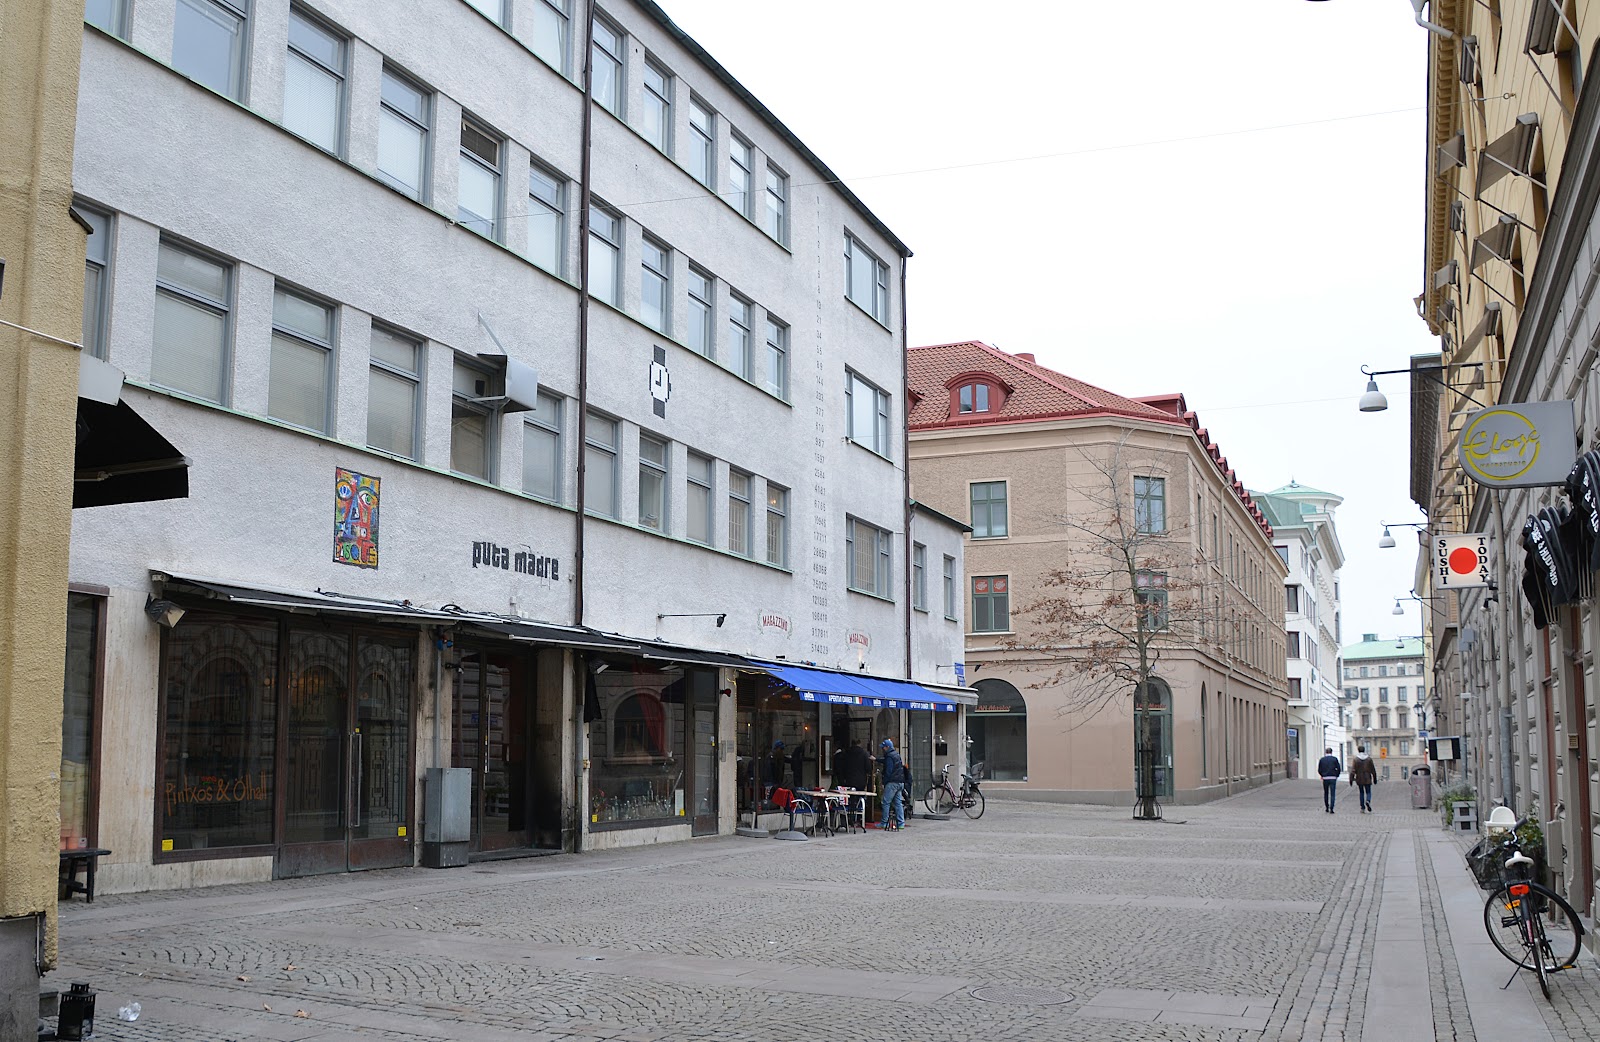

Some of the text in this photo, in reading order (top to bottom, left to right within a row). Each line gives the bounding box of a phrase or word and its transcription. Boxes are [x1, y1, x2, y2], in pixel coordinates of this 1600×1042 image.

[515, 551, 559, 581] madre
[813, 563, 828, 575] 46368
[1438, 539, 1449, 585] SUSHI
[1477, 537, 1489, 583] TODAY
[812, 595, 828, 607] 121393
[811, 627, 829, 639] 317811
[810, 643, 829, 655] 514229
[165, 773, 213, 817] Pintxos
[216, 778, 232, 801] &
